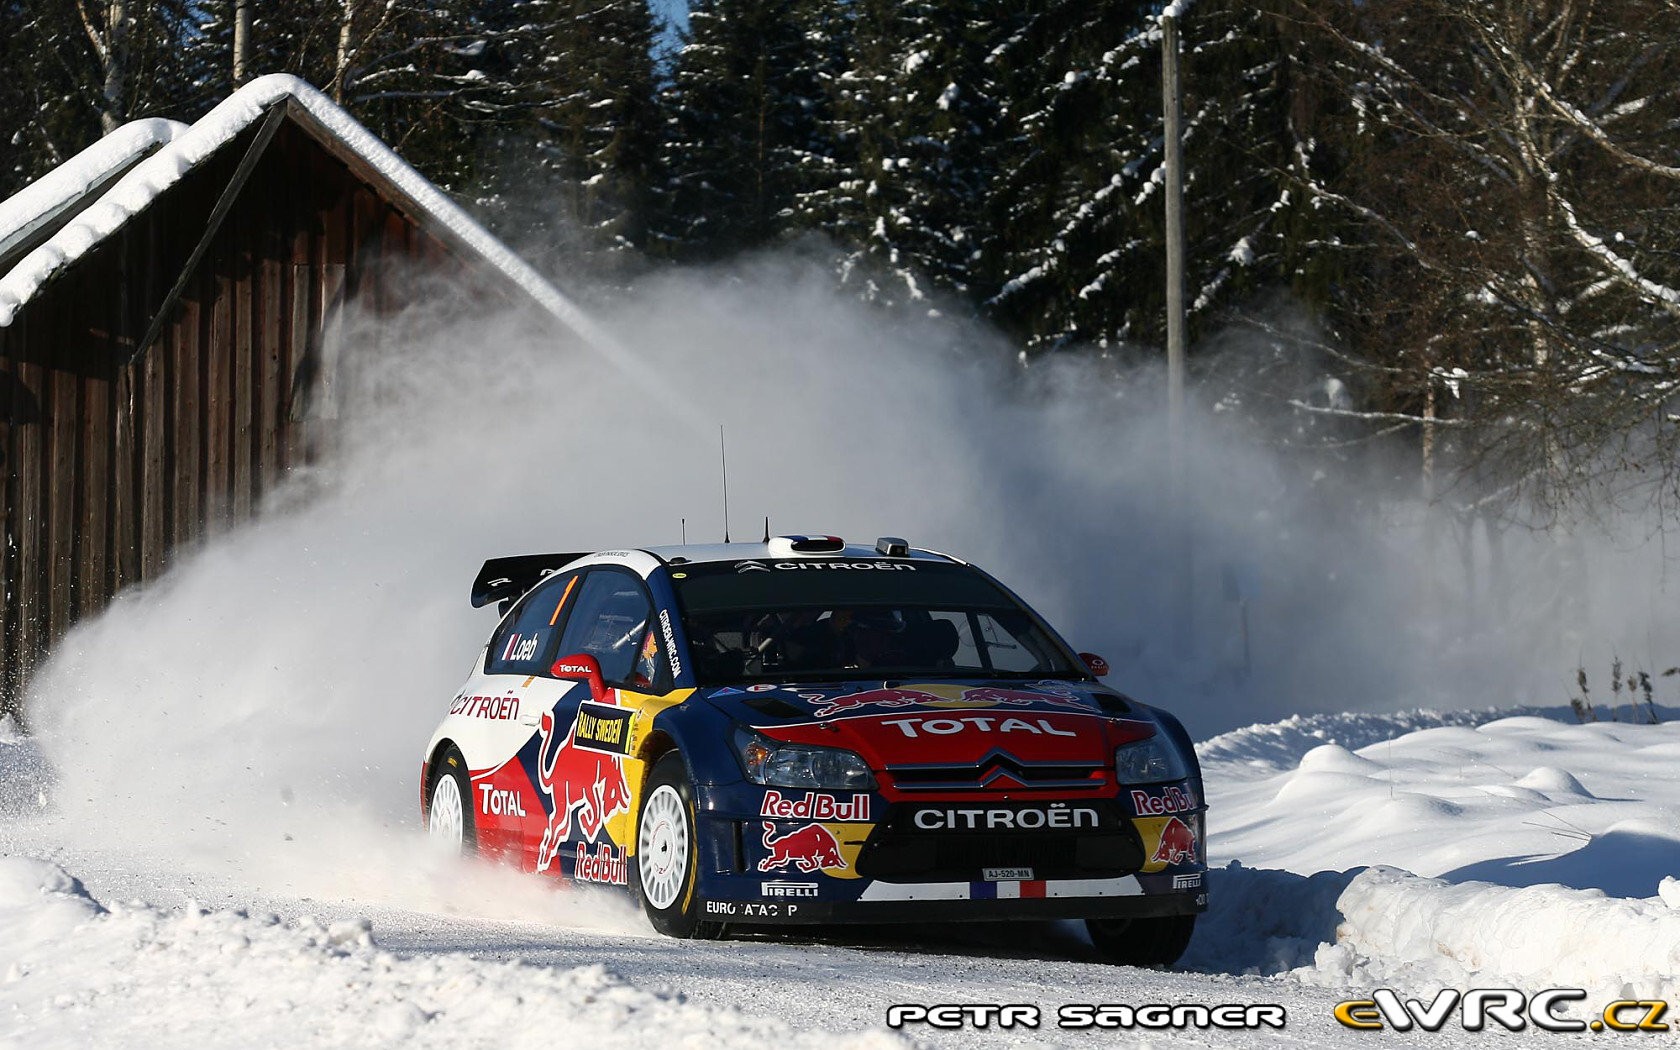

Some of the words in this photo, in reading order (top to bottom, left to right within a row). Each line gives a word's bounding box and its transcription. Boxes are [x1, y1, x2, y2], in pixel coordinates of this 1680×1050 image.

[510, 633, 538, 660] Loeb
[560, 664, 592, 673] TOTAL
[577, 711, 597, 739] RALLY
[595, 718, 623, 744] SWEDEN
[881, 718, 1076, 738] TOTAL
[478, 783, 526, 817] TOTAL
[760, 790, 814, 818] Red
[813, 794, 869, 820] Bull
[1130, 787, 1178, 815] Red
[575, 841, 602, 882] Red
[600, 844, 627, 885] Bull
[988, 869, 1030, 878] AJ-520-MN
[761, 882, 819, 896] PIRELLI
